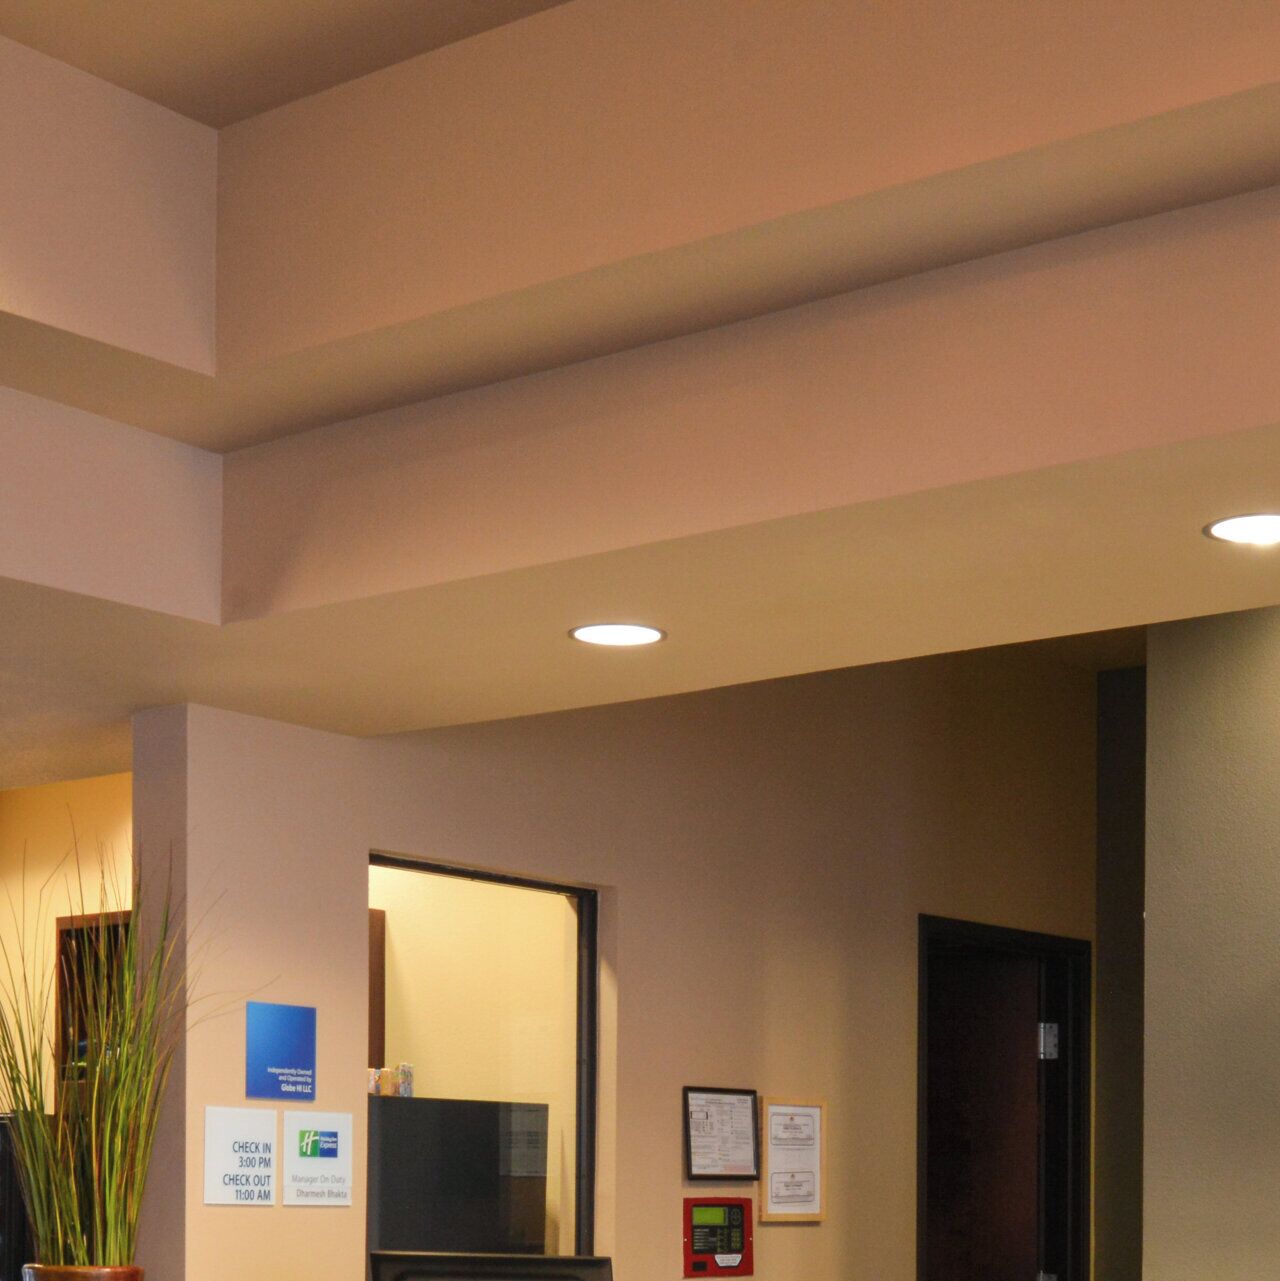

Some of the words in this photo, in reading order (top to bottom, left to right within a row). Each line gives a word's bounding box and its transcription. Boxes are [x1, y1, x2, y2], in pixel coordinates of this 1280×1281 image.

[232, 1141, 260, 1153] CHECK
[263, 1142, 271, 1154] IN
[239, 1156, 256, 1168] 3:00
[258, 1156, 271, 1168] PM
[223, 1173, 251, 1186] CHECK
[253, 1174, 271, 1186] OUT
[291, 1174, 319, 1185] Manager
[320, 1174, 329, 1184] On
[331, 1174, 345, 1185] Duty
[235, 1189, 255, 1200] 11:00
[257, 1189, 271, 1200] AM
